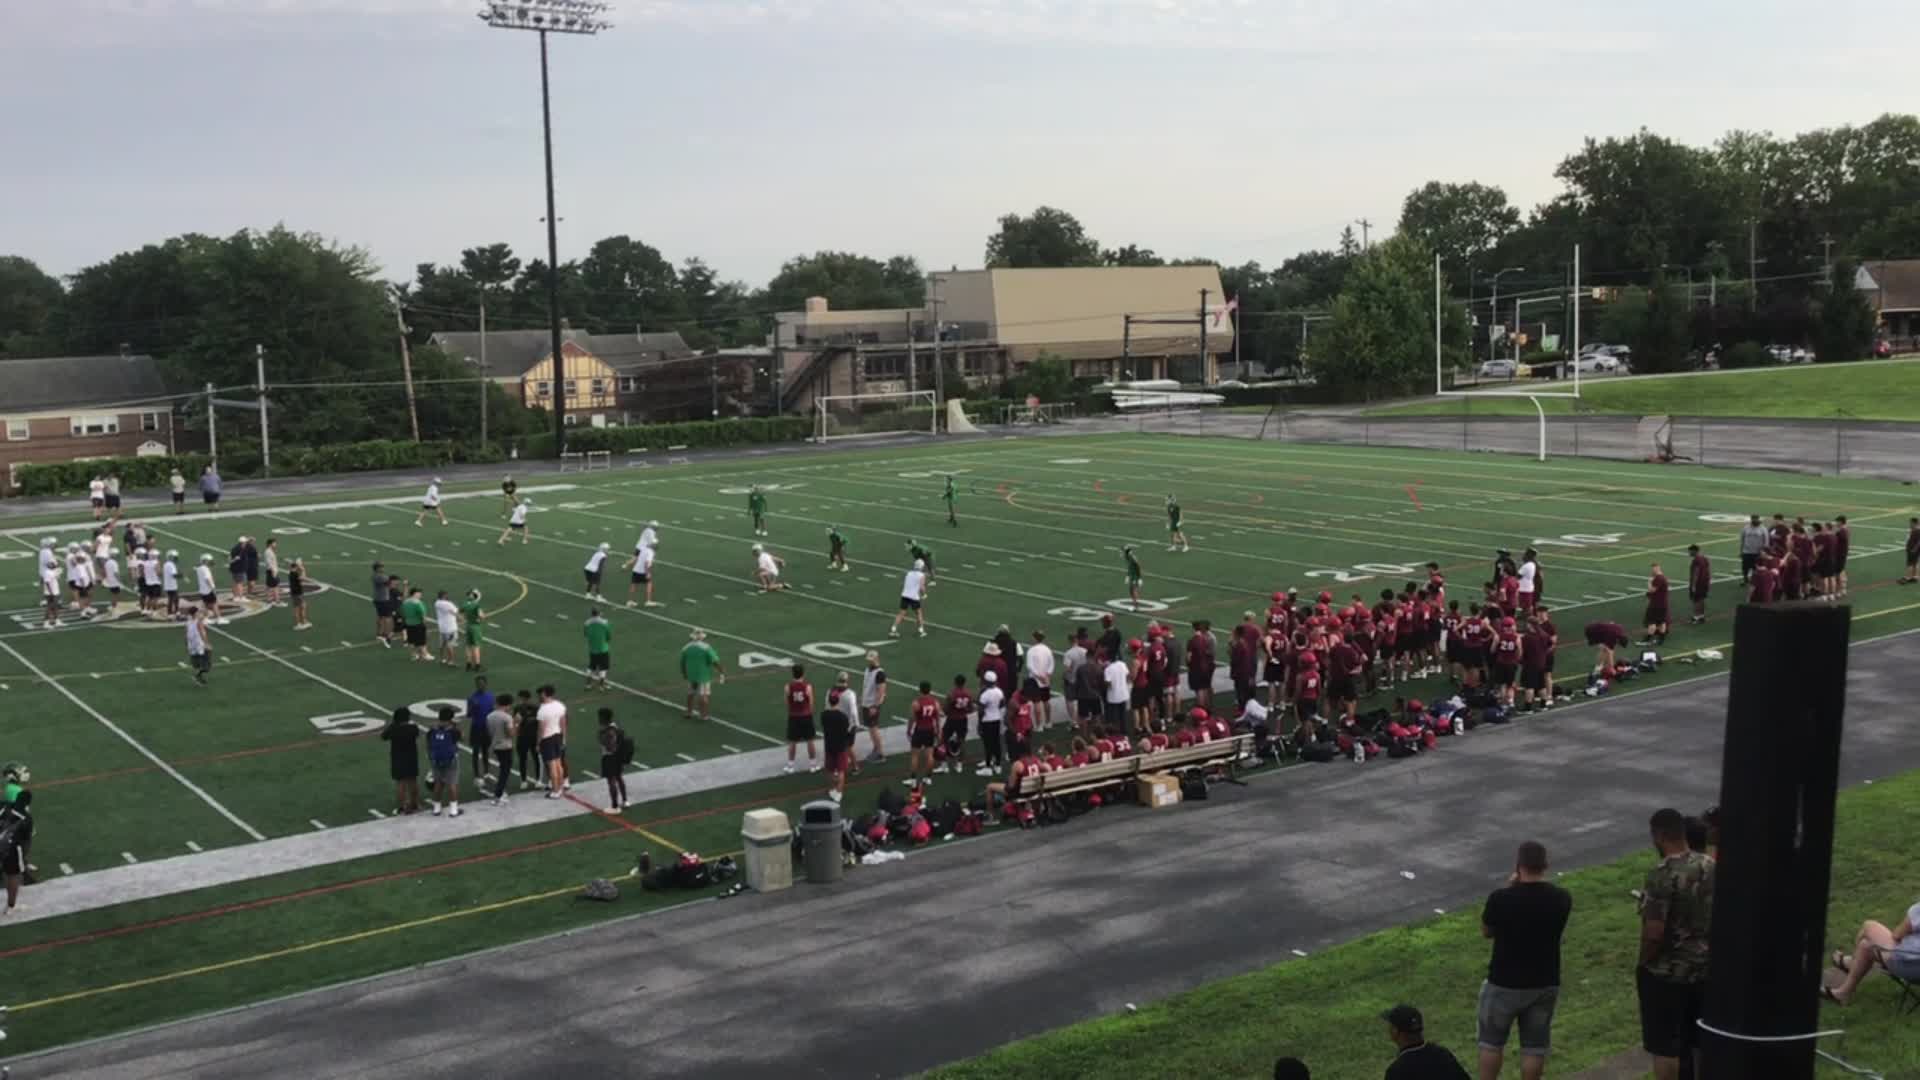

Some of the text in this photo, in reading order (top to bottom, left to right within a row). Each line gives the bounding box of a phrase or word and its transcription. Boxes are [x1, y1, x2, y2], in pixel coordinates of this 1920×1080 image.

[1303, 563, 1416, 582] 20
[1047, 598, 1170, 621] 30
[738, 641, 867, 668] 40
[309, 698, 469, 735] 50
[922, 704, 935, 717] 17
